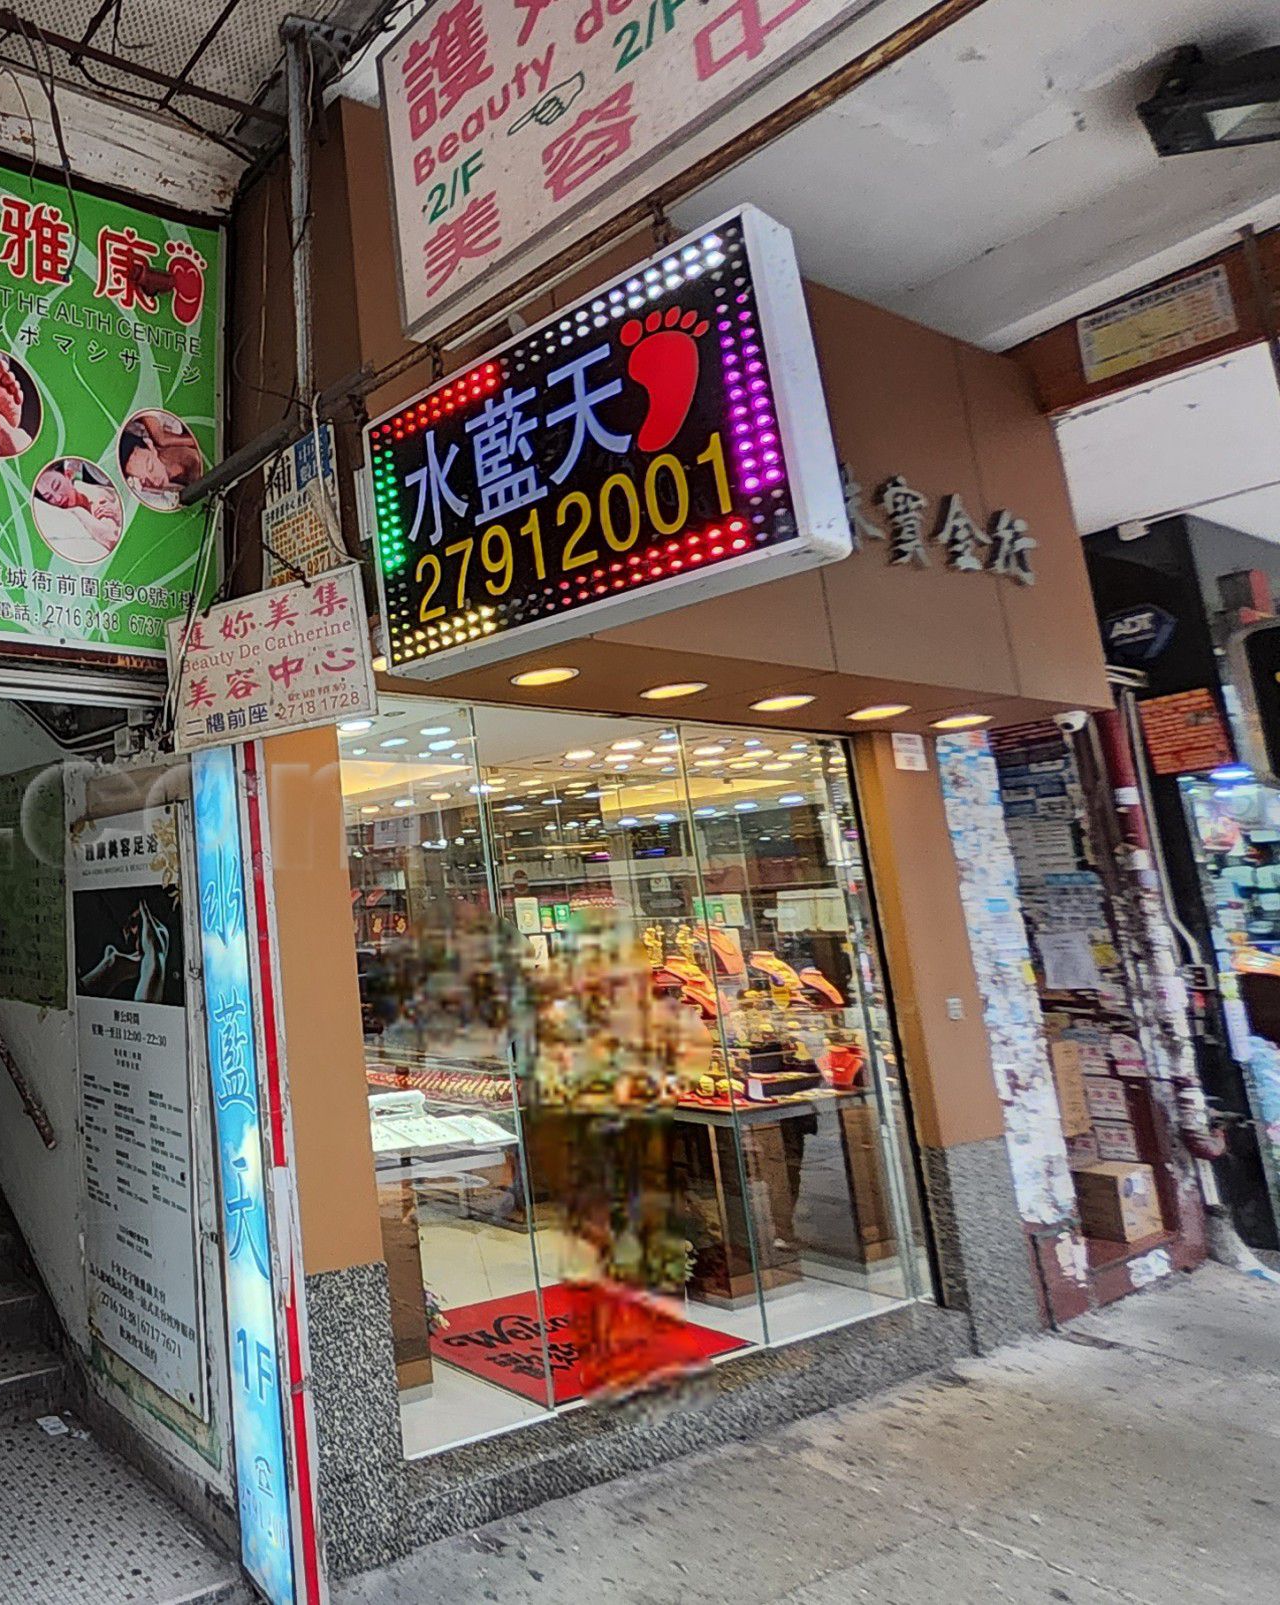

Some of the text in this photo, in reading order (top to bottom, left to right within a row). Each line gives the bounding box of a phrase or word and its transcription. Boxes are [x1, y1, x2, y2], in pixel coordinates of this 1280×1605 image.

[413, 42, 556, 186] Beauty
[427, 148, 484, 225] 2/F
[116, 318, 203, 357] CENTRE
[405, 342, 633, 547] 水藍天
[415, 431, 734, 624] 27912001
[238, 643, 261, 660] De
[264, 618, 353, 652] Catherine
[184, 647, 357, 711] 美容中心
[320, 690, 361, 712] 1728
[236, 1327, 275, 1404] 1F
